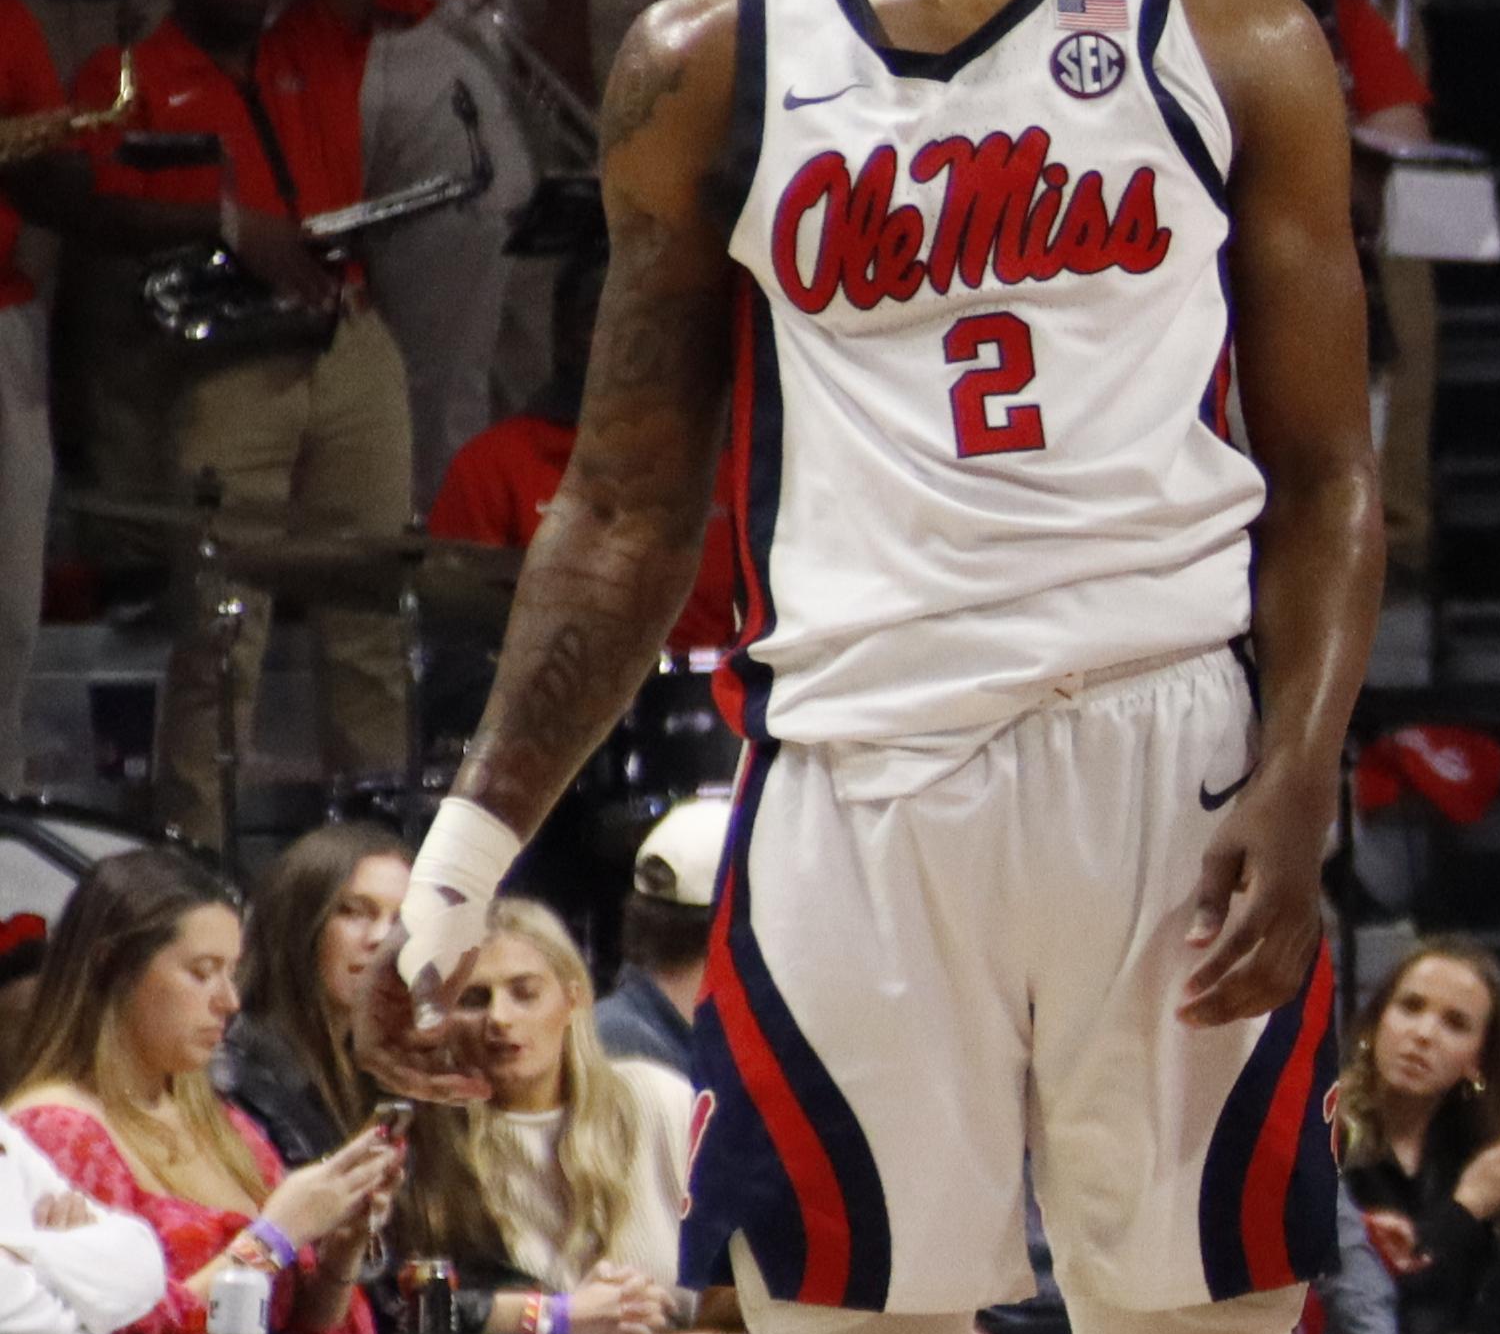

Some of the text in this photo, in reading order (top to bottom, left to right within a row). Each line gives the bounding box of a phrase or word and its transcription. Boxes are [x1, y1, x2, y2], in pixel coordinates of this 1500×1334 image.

[1056, 34, 1124, 96] SEC
[771, 125, 1171, 315] Ole Miss
[943, 311, 1046, 459] 2
